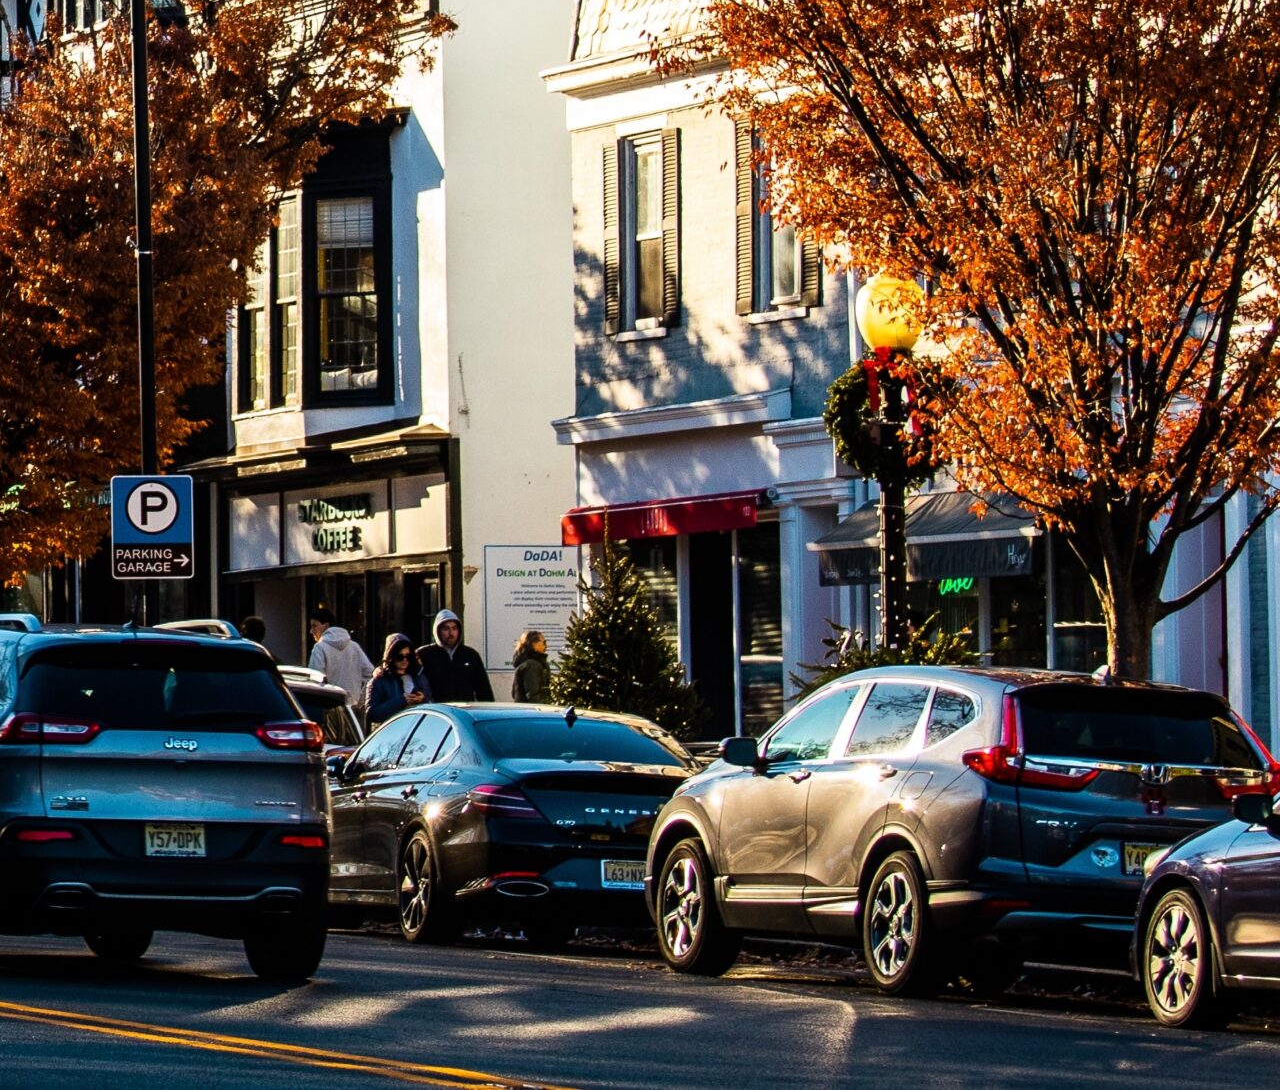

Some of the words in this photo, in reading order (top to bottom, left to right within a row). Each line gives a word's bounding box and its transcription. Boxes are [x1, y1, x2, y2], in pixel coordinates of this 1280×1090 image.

[312, 527, 358, 550] COFFEE
[116, 548, 173, 559] PARKING
[523, 550, 563, 562] DaDA!
[117, 562, 172, 573] GARAGE
[164, 737, 199, 751] Jeep
